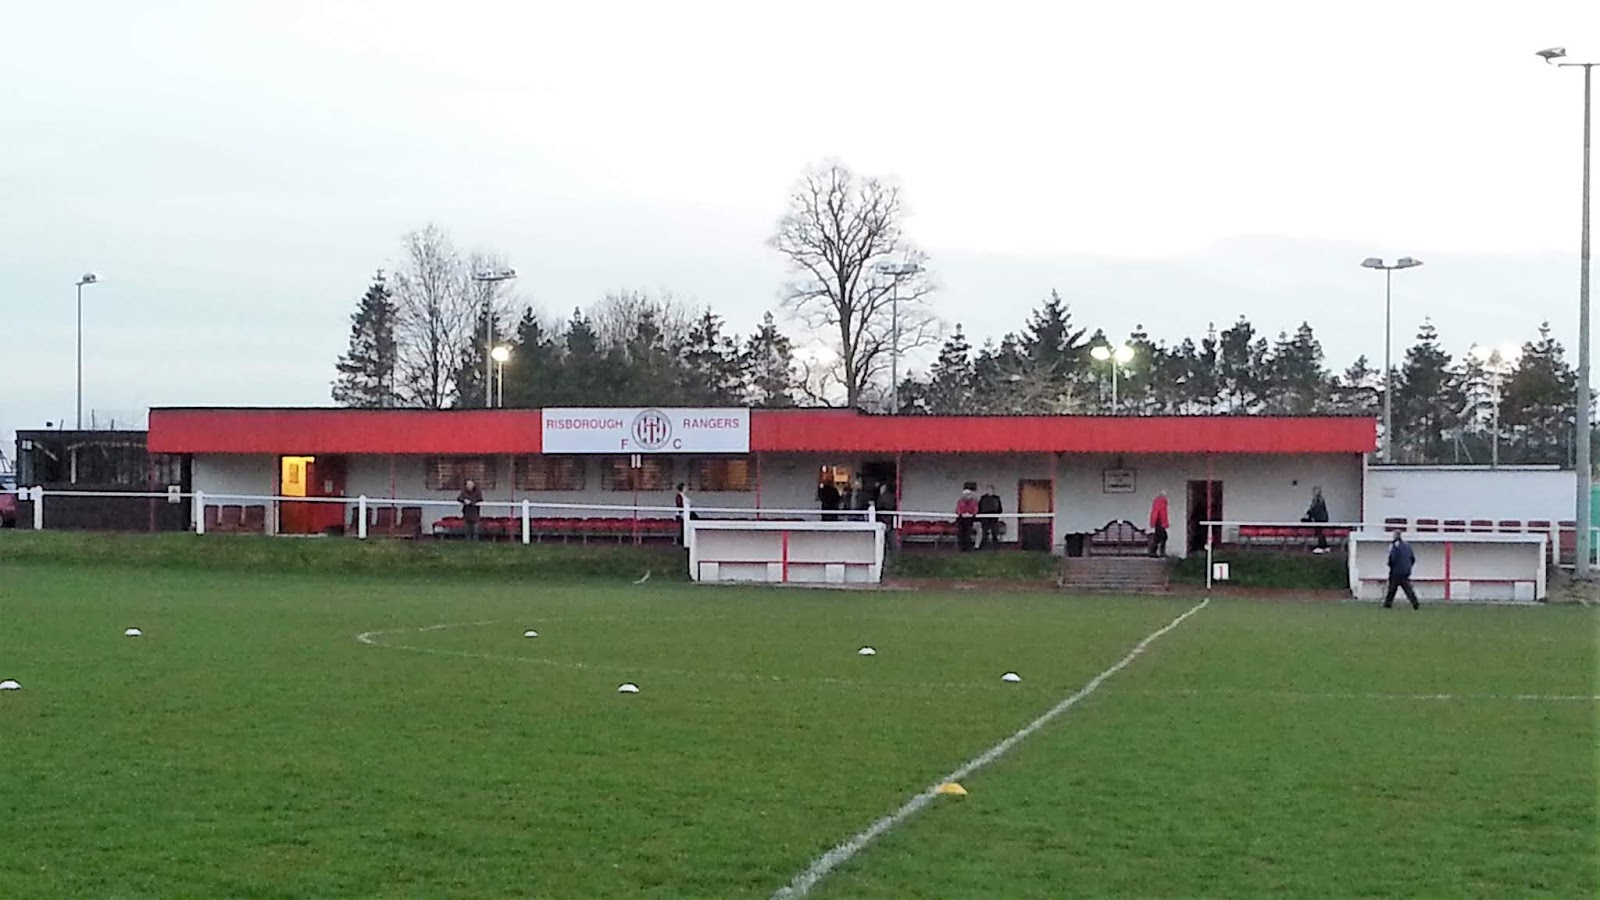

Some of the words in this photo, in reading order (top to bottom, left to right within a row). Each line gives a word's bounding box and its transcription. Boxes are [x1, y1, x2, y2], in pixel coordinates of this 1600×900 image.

[546, 418, 623, 429] RISBOROUGH
[683, 418, 740, 429] RANGERS
[621, 438, 629, 450] F
[673, 438, 682, 450] C
